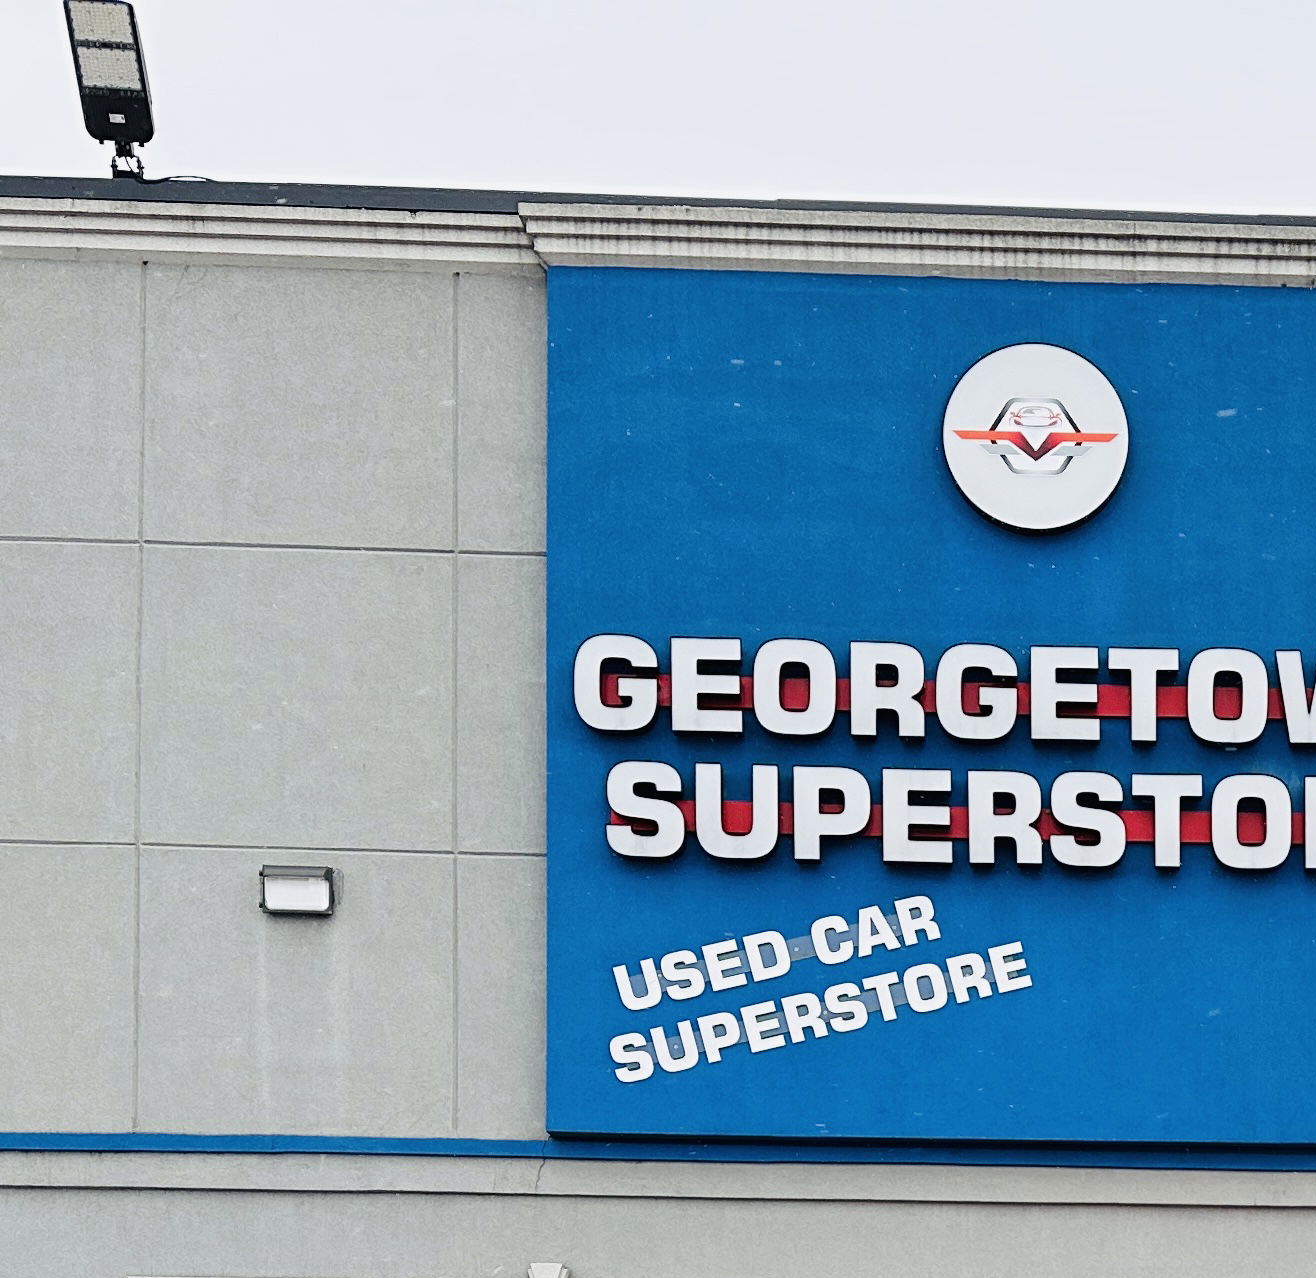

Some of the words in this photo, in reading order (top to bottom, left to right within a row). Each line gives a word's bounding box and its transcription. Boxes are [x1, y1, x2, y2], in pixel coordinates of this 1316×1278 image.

[608, 940, 1034, 1085] SUPERSTORE
[612, 929, 792, 1012] USED
[809, 894, 942, 967] CAR
